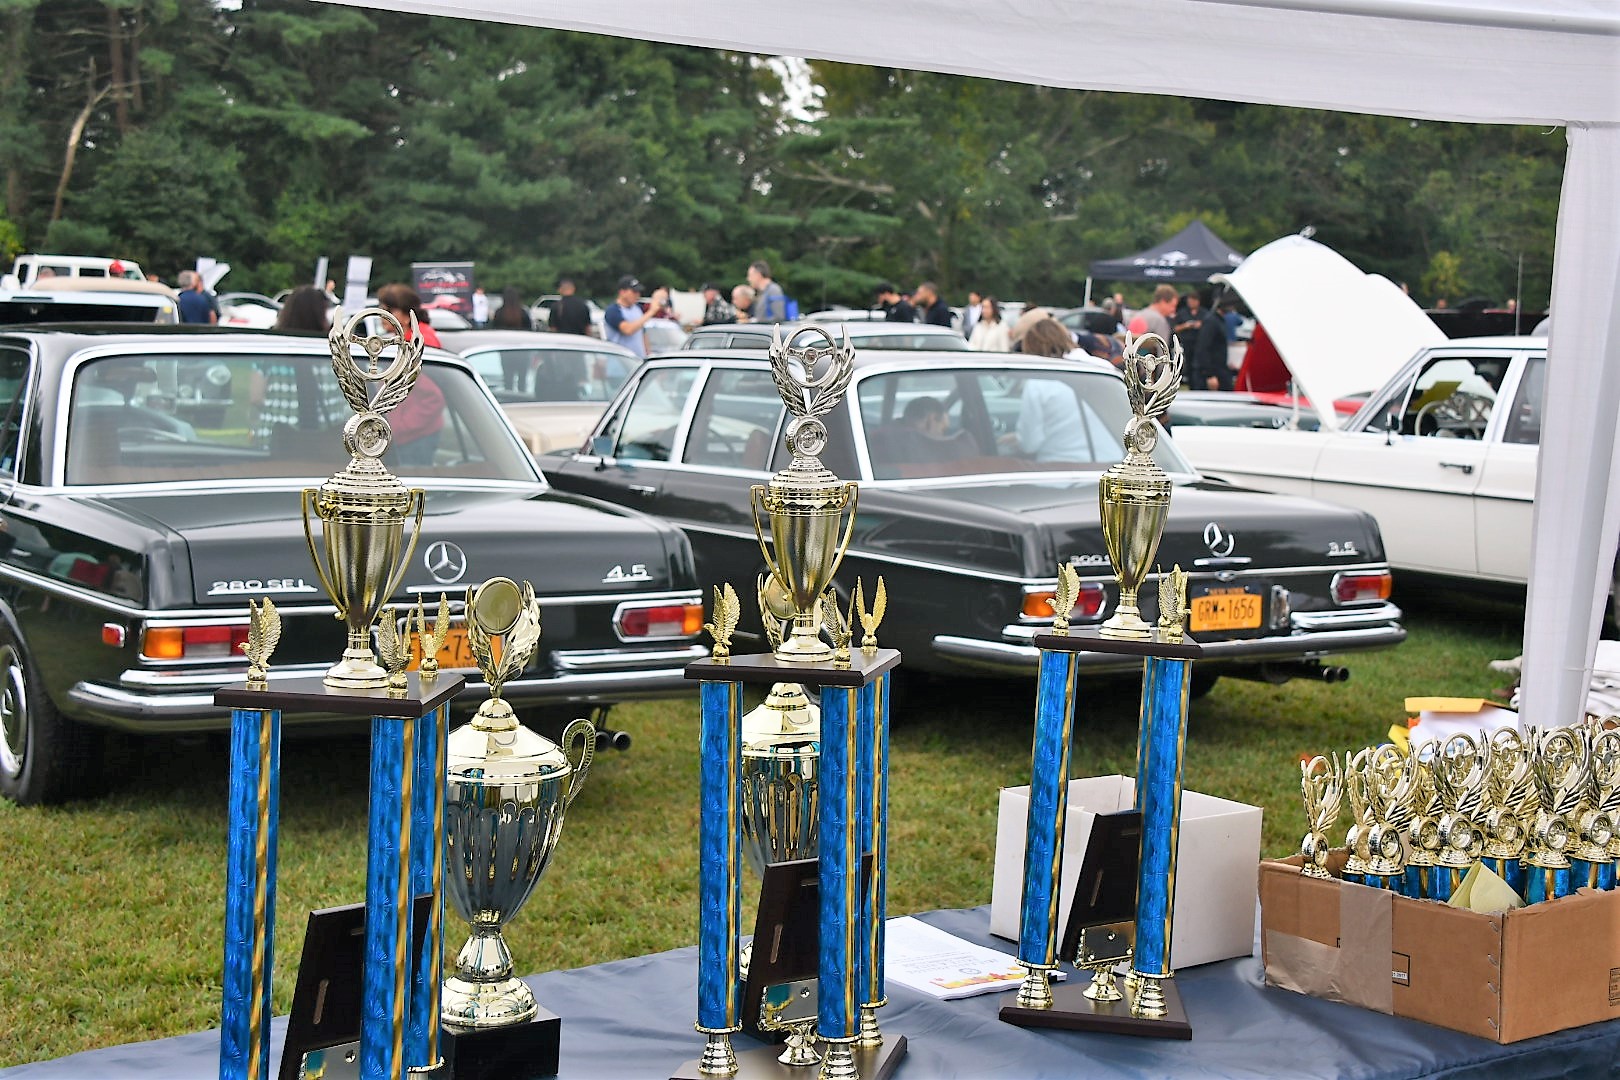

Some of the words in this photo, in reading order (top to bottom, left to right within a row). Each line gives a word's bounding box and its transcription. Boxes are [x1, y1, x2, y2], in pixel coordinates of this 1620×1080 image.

[606, 564, 648, 579] 4.5
[212, 579, 263, 592] 280
[266, 578, 313, 591] SEL
